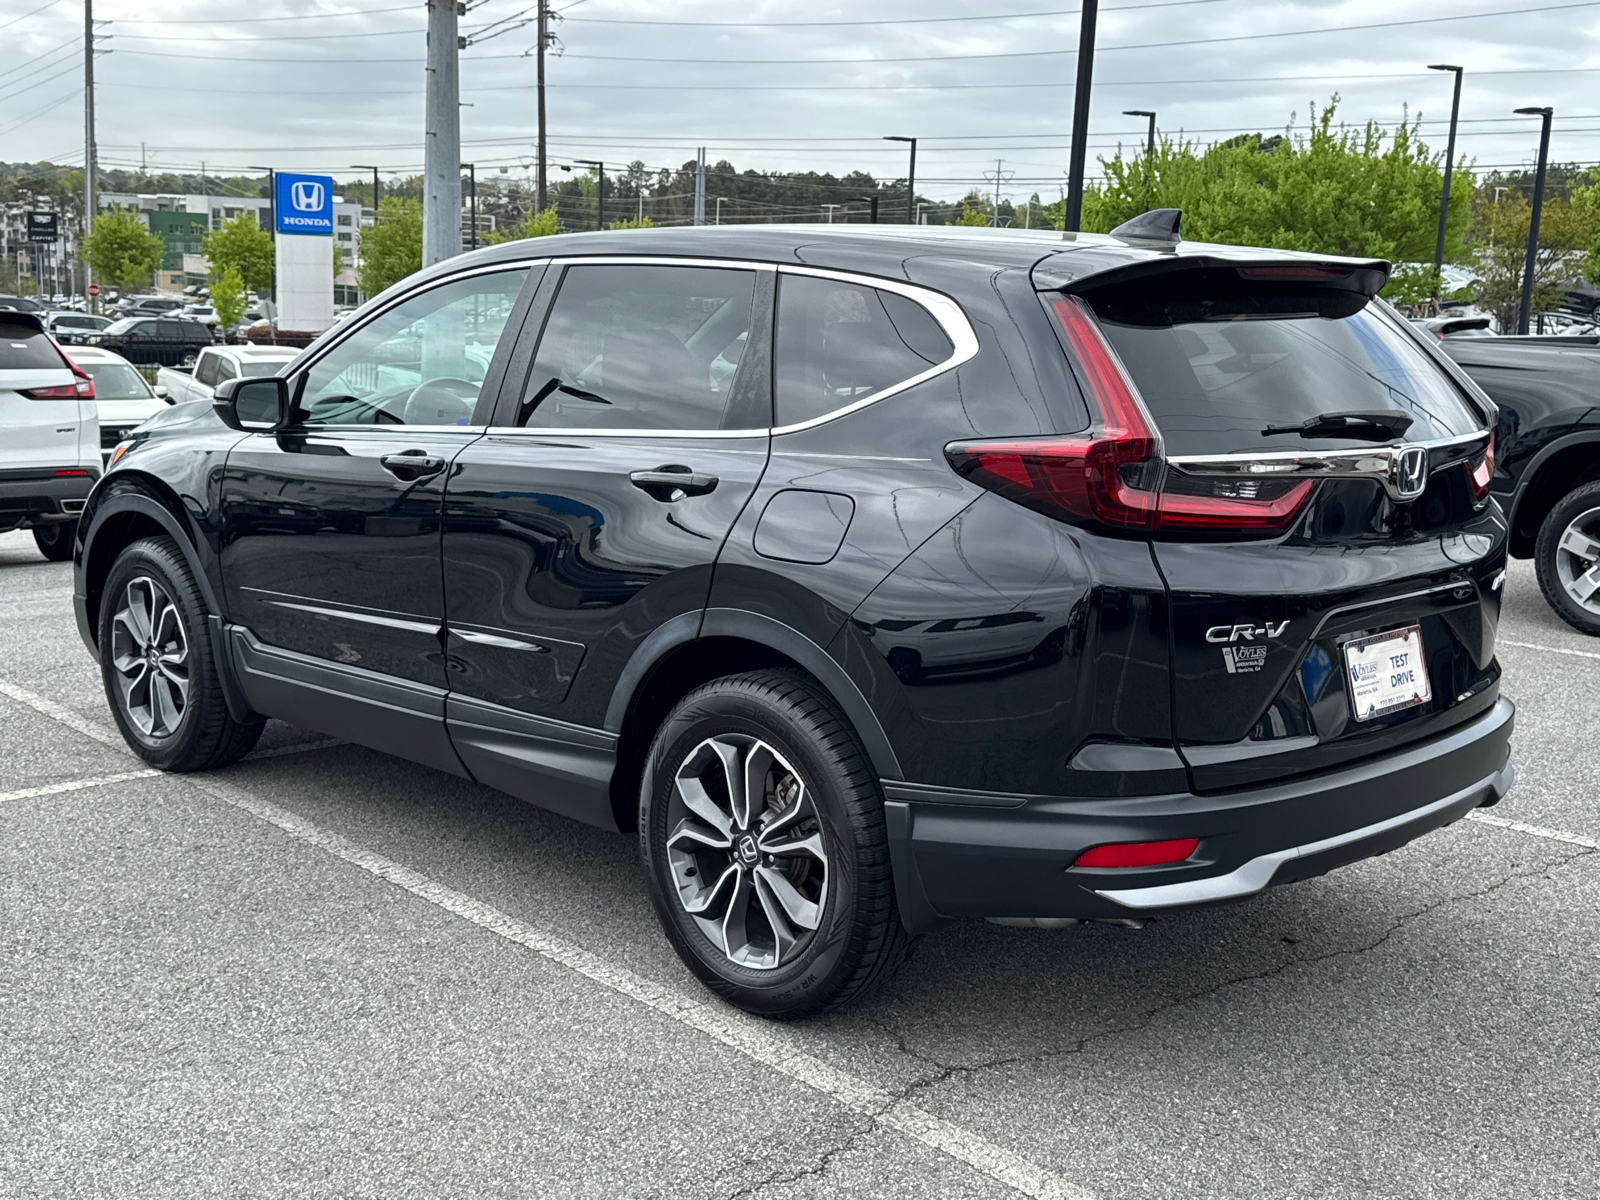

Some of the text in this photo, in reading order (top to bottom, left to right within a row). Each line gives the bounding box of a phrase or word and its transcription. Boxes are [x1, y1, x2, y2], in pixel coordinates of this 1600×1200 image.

[283, 216, 331, 227] HONDA
[1205, 619, 1290, 643] CR-V
[1236, 660, 1258, 668] HONDA
[1389, 652, 1409, 669] TEST
[1390, 670, 1415, 688] DRIVE
